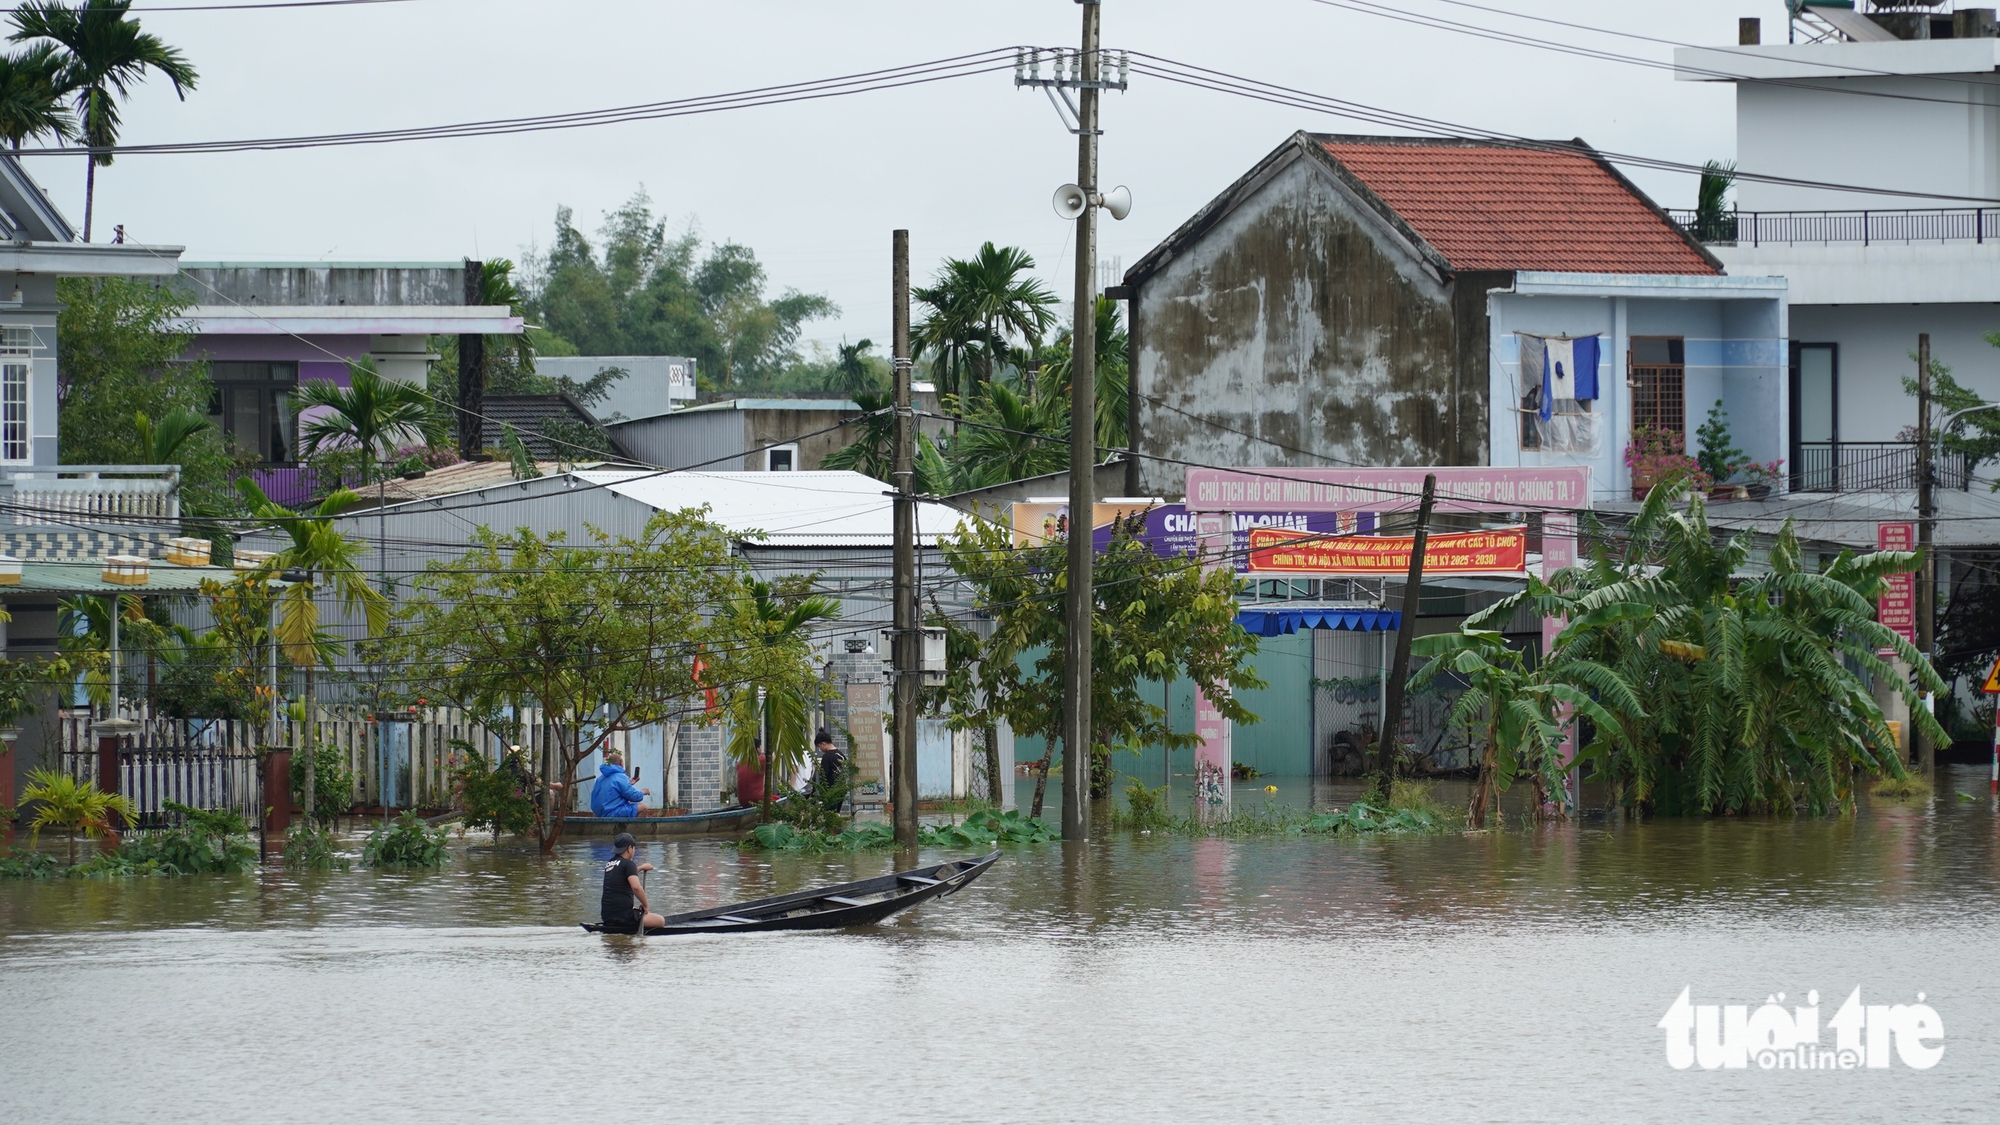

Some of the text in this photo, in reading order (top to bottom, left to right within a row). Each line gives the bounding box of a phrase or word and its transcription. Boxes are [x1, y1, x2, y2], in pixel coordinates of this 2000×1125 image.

[1199, 475, 1219, 501] CHỦ
[1222, 481, 1244, 506] TỊCH
[1247, 475, 1261, 501] HỒ
[1263, 477, 1281, 501] CHÍ
[1284, 482, 1311, 502] MINH
[1313, 479, 1324, 502] VĨ
[1325, 483, 1343, 506] ĐẠI
[1346, 476, 1374, 502] SỐNG
[1377, 479, 1397, 502] MÃI
[1400, 482, 1424, 502] TRON
[1437, 479, 1451, 506] SỰ
[1454, 477, 1491, 506] NGHIỆP
[1494, 474, 1515, 501] CỦA
[1518, 476, 1554, 501] CHÚNG
[1557, 481, 1568, 500] TA
[1256, 534, 1275, 547] CHÀO
[1321, 540, 1337, 551] ĐẠI
[1338, 539, 1354, 550] BIỂU
[1354, 540, 1372, 552] MẶT
[1467, 536, 1484, 548] CÁC
[1485, 535, 1495, 548] TỔ
[1496, 535, 1517, 548] CHỨC
[1272, 553, 1292, 565] CHÍNH
[1294, 554, 1307, 567] TRỊ,
[1319, 553, 1331, 568] HỘI
[1332, 553, 1342, 566] XÃ
[1342, 553, 1356, 566] HÒA
[1357, 555, 1375, 567] VANG
[1376, 553, 1390, 567] LẦN
[1391, 554, 1406, 567] THỨ
[1439, 553, 1450, 566] KỲ
[1450, 555, 1469, 566] 2025
[1475, 554, 1497, 566] 2030!
[862, 784, 878, 794] 2024
